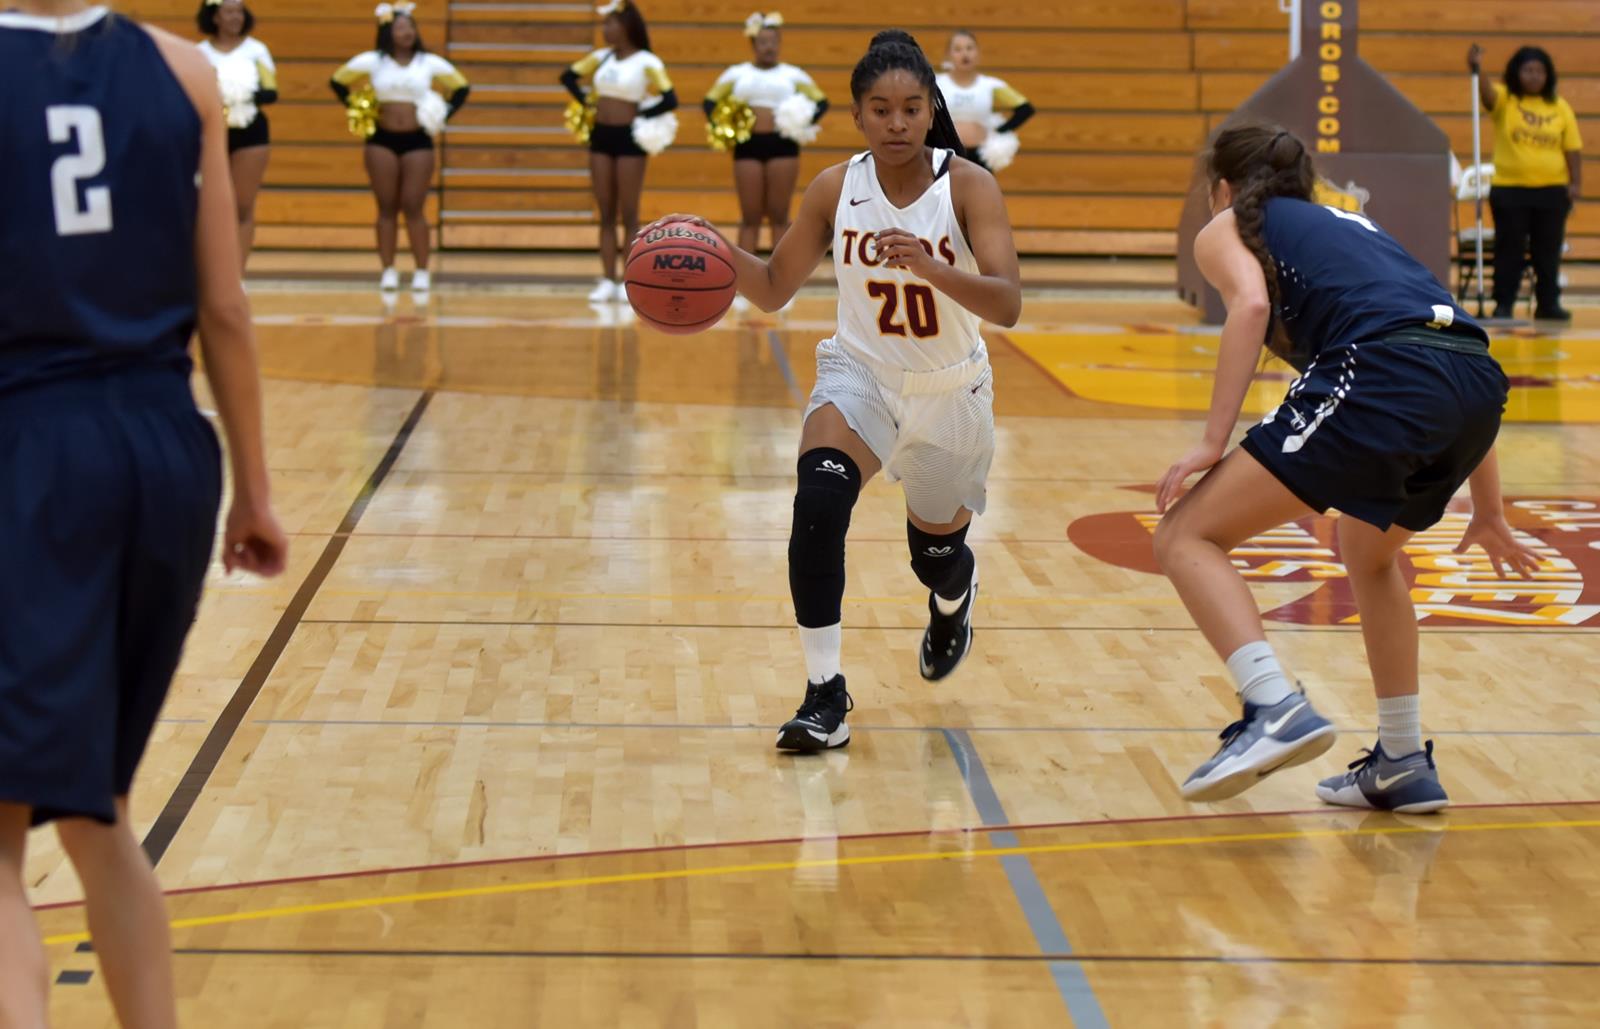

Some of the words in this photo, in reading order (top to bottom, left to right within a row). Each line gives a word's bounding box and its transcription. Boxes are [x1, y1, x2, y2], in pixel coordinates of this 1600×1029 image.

[46, 105, 113, 236] 2
[645, 226, 718, 248] Wilson
[842, 229, 956, 269] TOS
[653, 254, 706, 272] NCAA
[866, 280, 940, 338] 20
